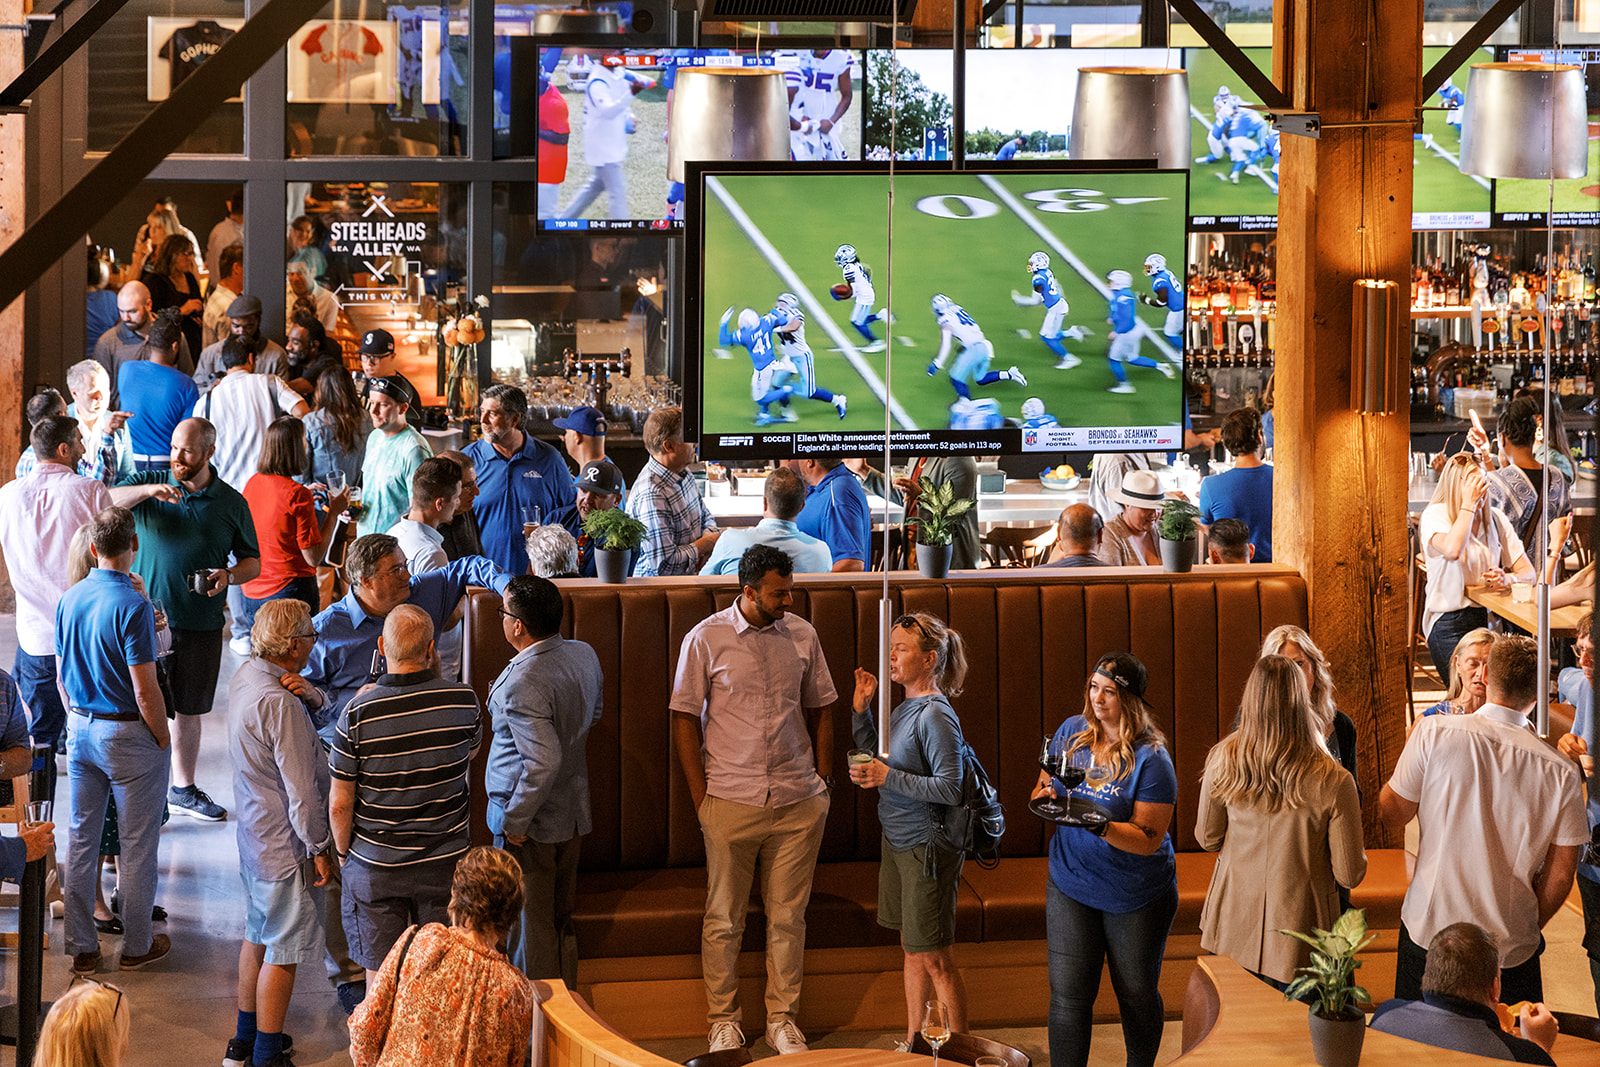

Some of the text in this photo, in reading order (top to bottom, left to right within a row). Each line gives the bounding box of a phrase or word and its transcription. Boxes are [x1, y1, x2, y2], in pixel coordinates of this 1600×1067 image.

[180, 42, 222, 62] GOPHE
[331, 222, 426, 241] STEELHEADS
[352, 243, 403, 256] ALLEY
[752, 331, 771, 356] 41
[797, 434, 817, 442] Ellen
[818, 433, 842, 442] White
[889, 432, 931, 440] retirement
[1088, 429, 1117, 439] BRONCOS
[1124, 429, 1158, 439] SEAHAWKS
[719, 436, 753, 447] ESPN
[797, 444, 830, 453] England's
[831, 443, 857, 451] all-time
[858, 443, 883, 451] leading
[940, 441, 949, 449] 52
[949, 441, 968, 450] goals
[968, 441, 976, 449] in
[976, 441, 988, 449] 113
[988, 442, 1002, 450] app
[584, 467, 600, 482] R
